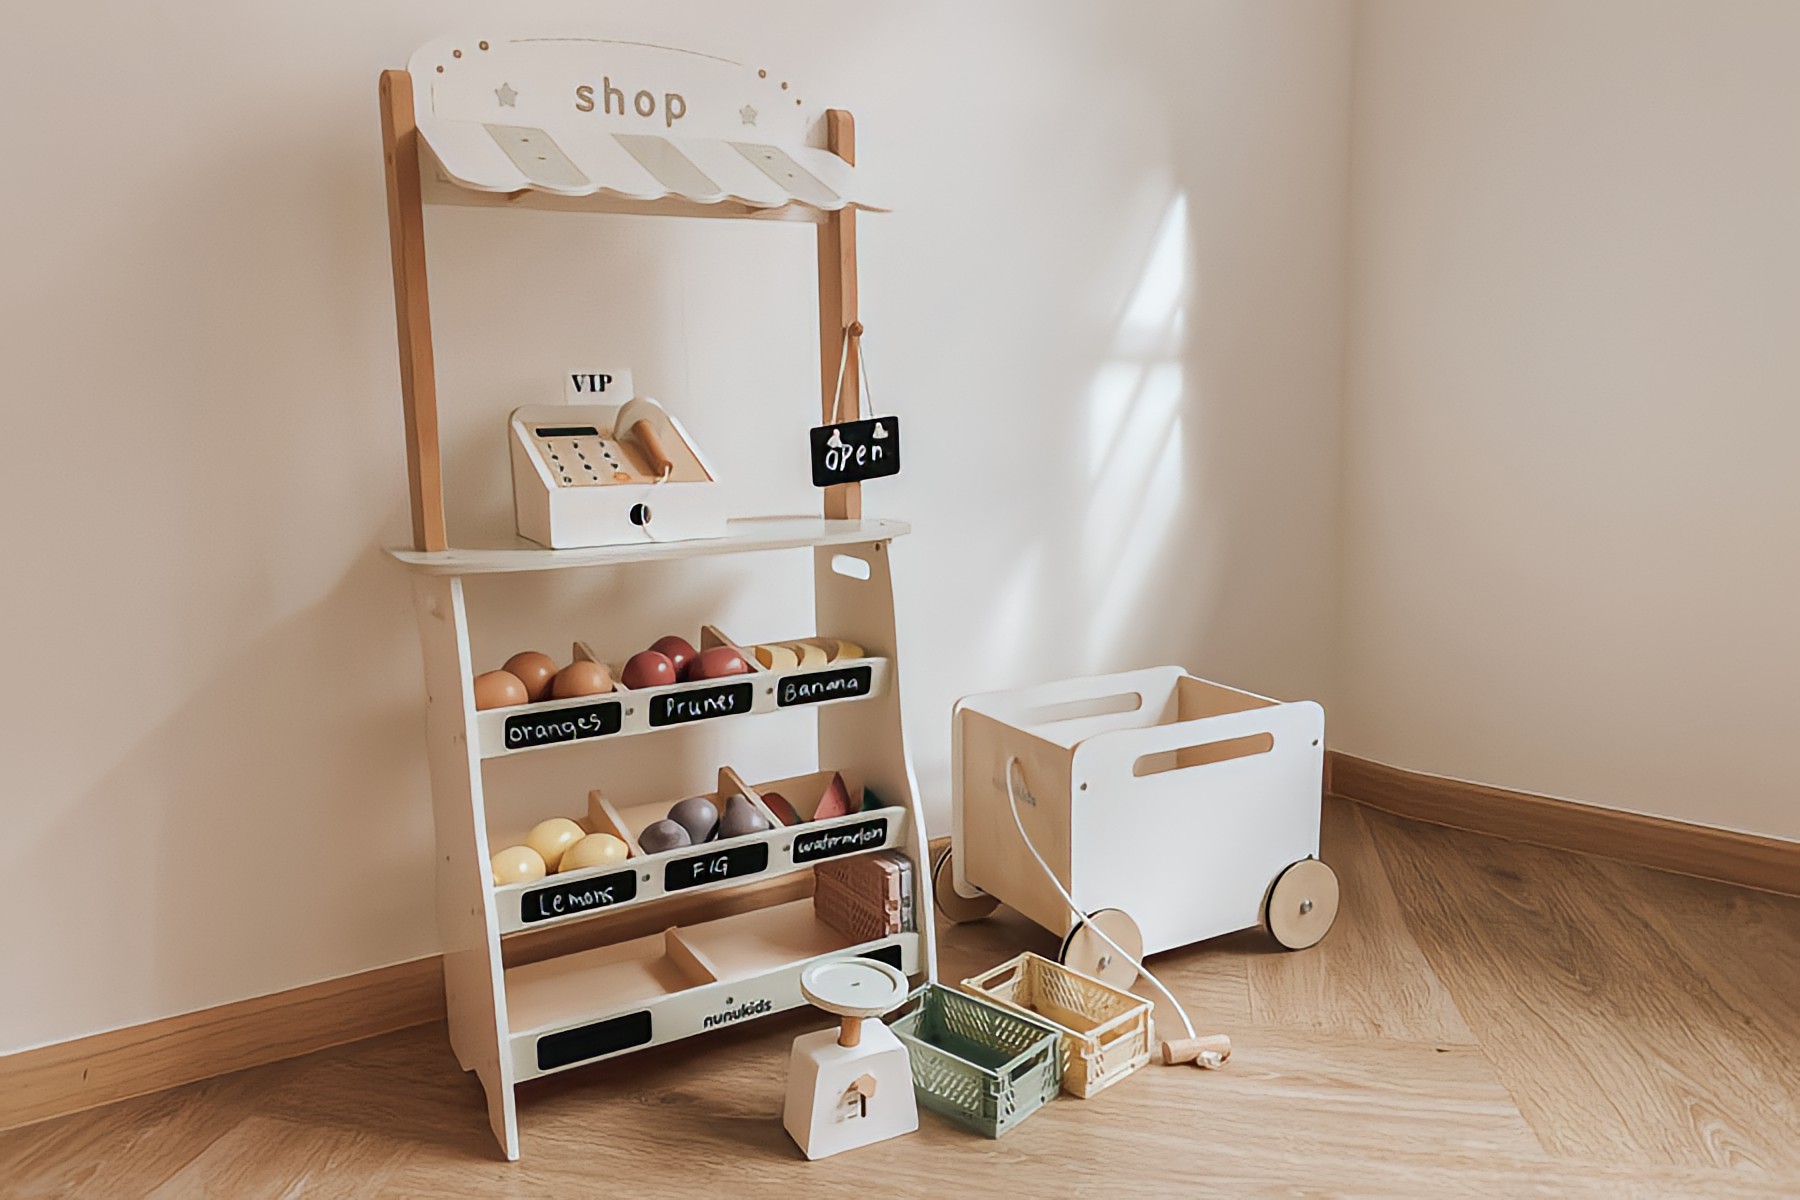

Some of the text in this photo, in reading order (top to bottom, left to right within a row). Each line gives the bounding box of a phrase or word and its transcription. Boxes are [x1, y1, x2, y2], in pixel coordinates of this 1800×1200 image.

[576, 76, 687, 127] shop
[571, 373, 613, 393] VIP
[785, 678, 858, 703] Banana
[666, 693, 734, 718] Prunes
[693, 856, 728, 878] FIG
[539, 886, 614, 916] Lemons
[703, 999, 772, 1029] nunukids
